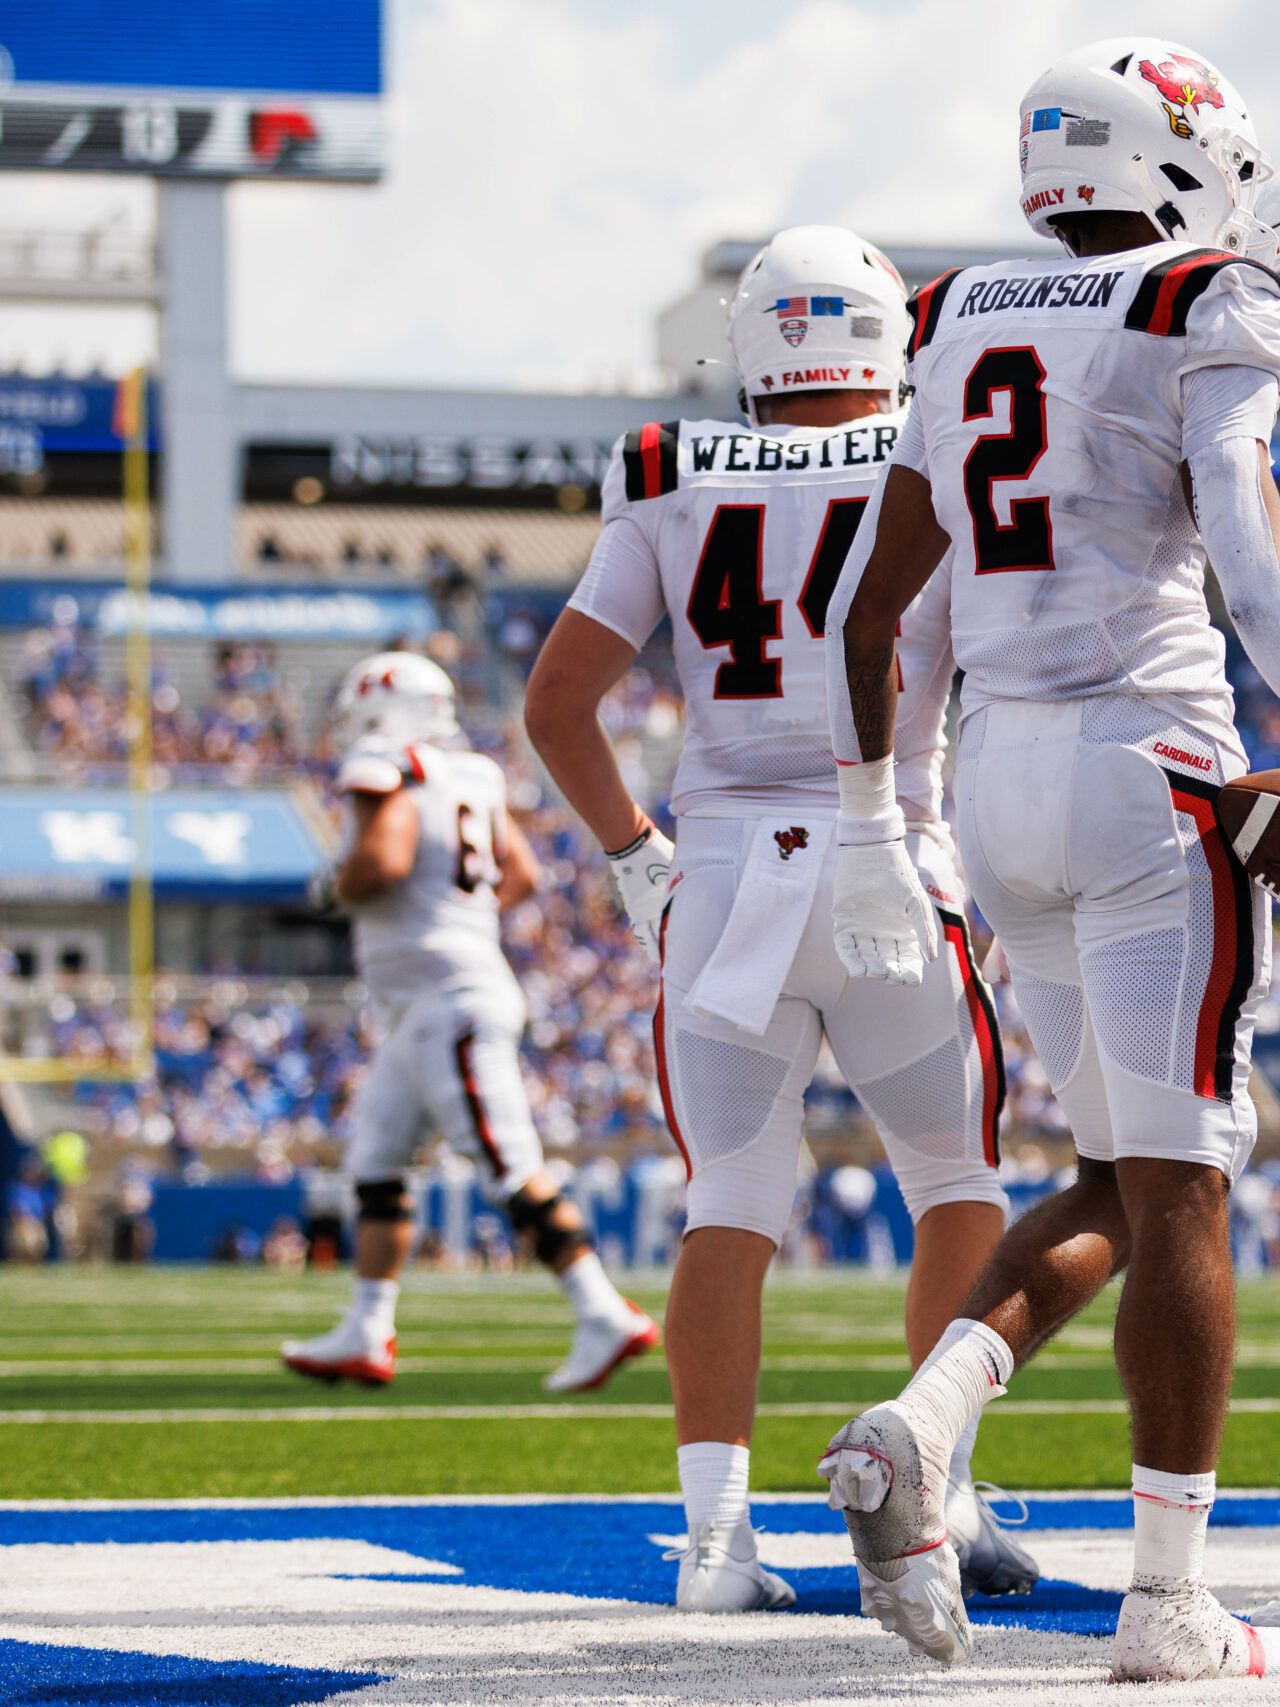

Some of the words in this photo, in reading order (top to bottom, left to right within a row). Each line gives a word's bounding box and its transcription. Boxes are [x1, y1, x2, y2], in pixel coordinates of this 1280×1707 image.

[1022, 187, 1064, 217] FAMILY
[957, 271, 1124, 318] ROBINSON
[782, 368, 851, 386] FAMILY
[690, 426, 899, 472] WEBSTER
[962, 345, 1056, 575] 2
[1153, 741, 1212, 771] CARDINALS
